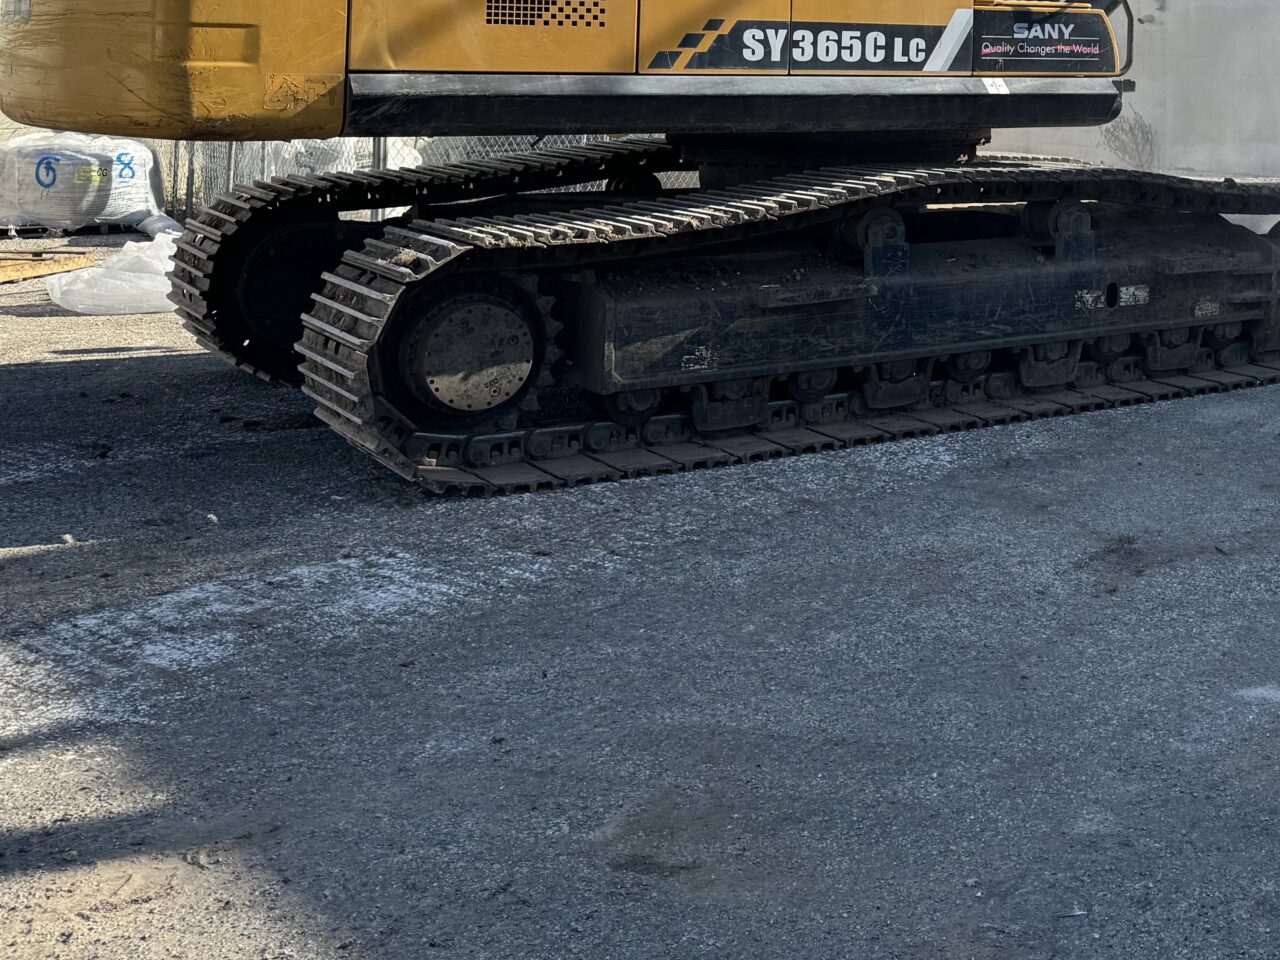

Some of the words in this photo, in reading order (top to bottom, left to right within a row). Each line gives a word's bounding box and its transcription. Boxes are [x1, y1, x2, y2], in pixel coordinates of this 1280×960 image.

[1013, 23, 1075, 40] SANY
[742, 28, 886, 63] SY365C
[893, 37, 926, 63] LC
[981, 41, 1015, 55] Quality
[1017, 42, 1056, 56] Changes
[1057, 43, 1071, 54] the
[1072, 43, 1099, 54] World
